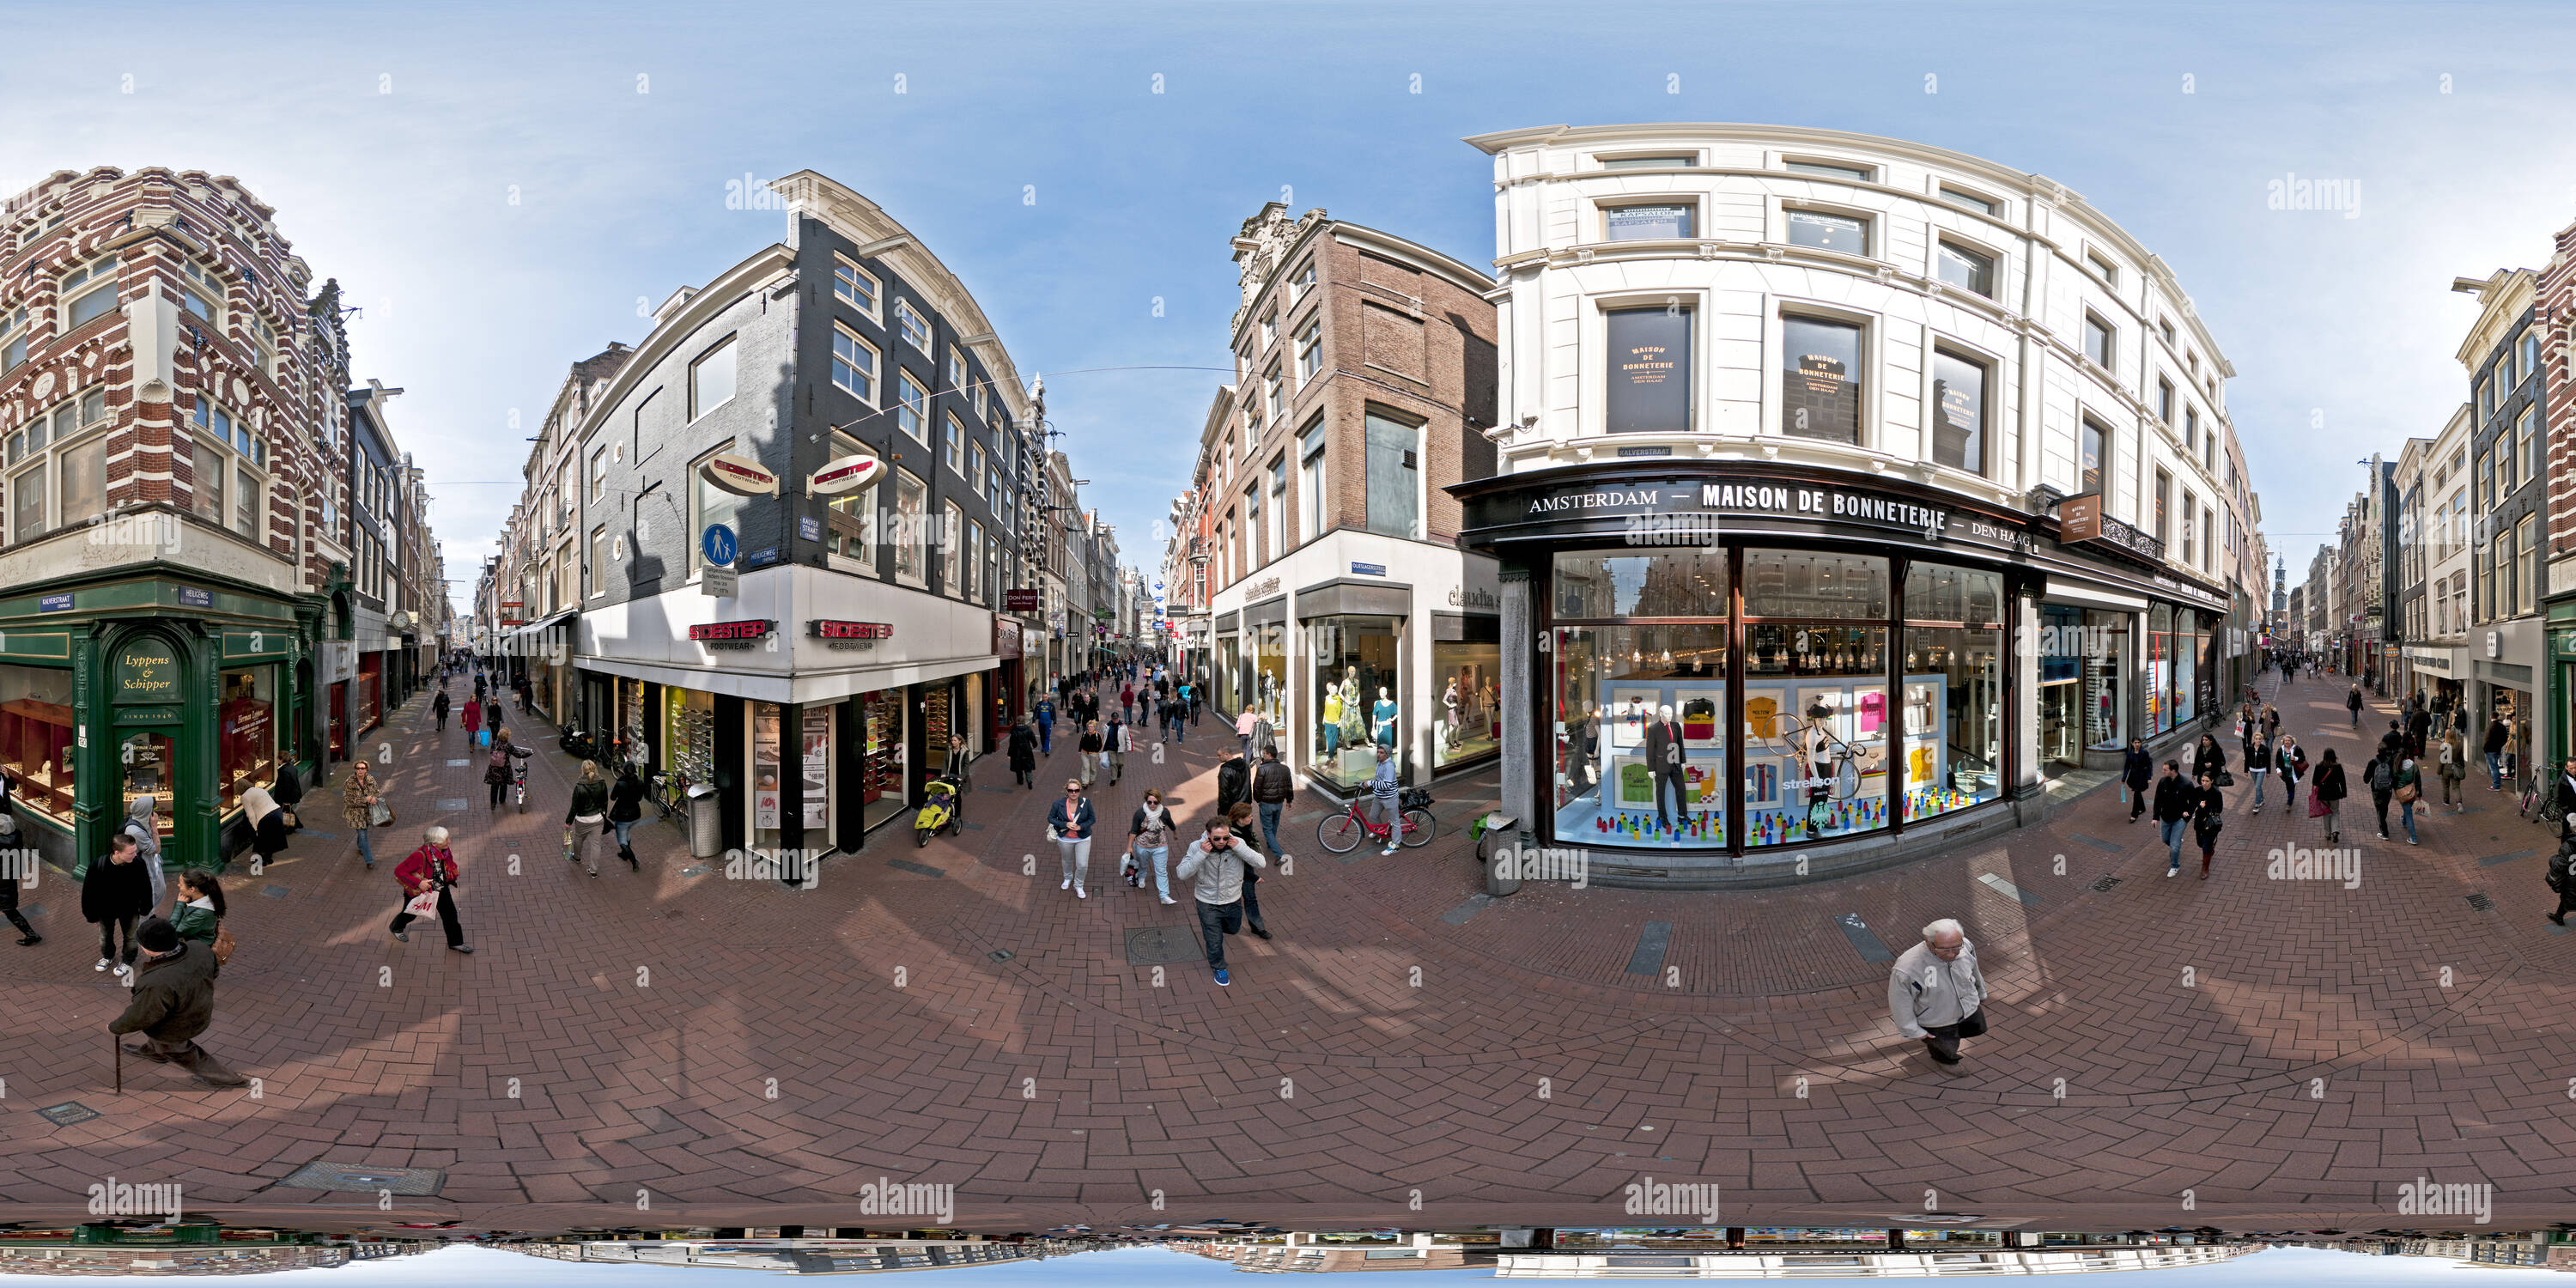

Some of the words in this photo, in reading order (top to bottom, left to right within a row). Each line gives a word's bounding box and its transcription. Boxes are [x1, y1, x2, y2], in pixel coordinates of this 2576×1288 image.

[1807, 355, 1838, 364] MAISON
[1799, 368, 1845, 381] BONNETERIE
[730, 474, 759, 486] FOOTWEAR
[828, 475, 857, 486] FOOTWEAR
[1529, 490, 1657, 513] AMSTERDAM
[1703, 484, 1788, 509] MAISON
[1798, 489, 1824, 513] DE
[1832, 493, 1945, 531] BONNETERIE
[1971, 523, 1997, 539] DEN
[2000, 531, 2030, 547] HAAG
[803, 517, 818, 526] KALVER
[803, 526, 817, 534] STRAAT
[750, 551, 775, 560] HEILIGEWEG
[185, 589, 209, 599] HEILIGEWEG
[1449, 585, 1493, 608] claudia
[43, 595, 70, 605] KALVERSTRAAT
[690, 621, 765, 639] SIDESTEP
[820, 622, 893, 639] SIDESTEP
[710, 642, 750, 651] FOOTWEAR
[125, 655, 169, 666] Lyppens
[143, 668, 154, 677] &
[124, 679, 171, 690] Schipper
[238, 714, 251, 724] Herman
[1783, 776, 1839, 790] strellson
[412, 902, 432, 912] H&M
